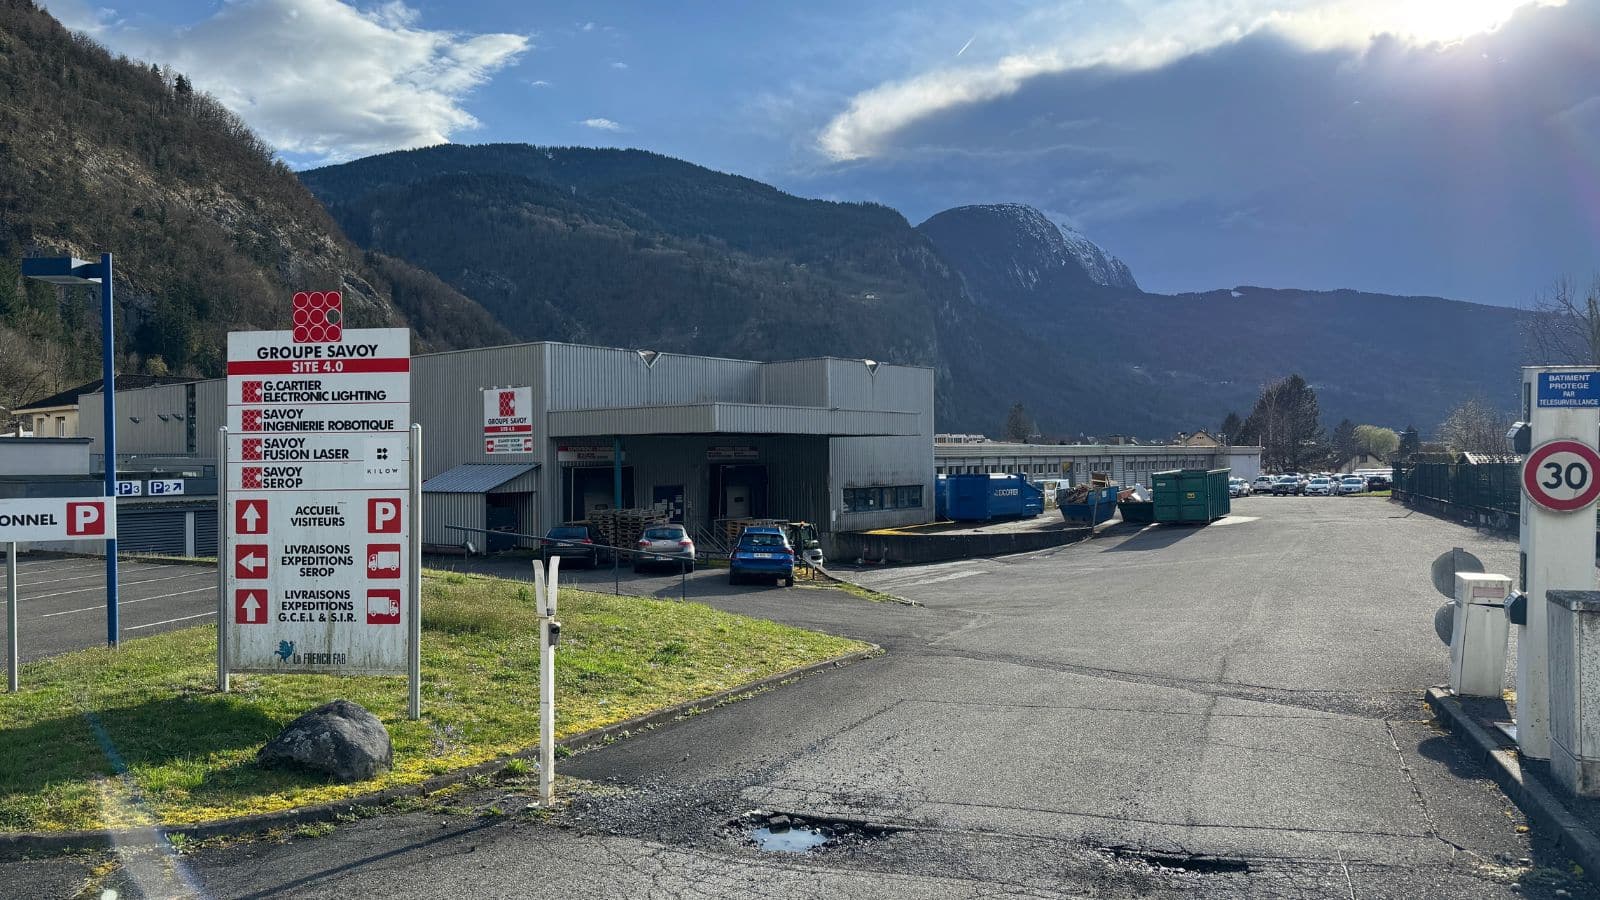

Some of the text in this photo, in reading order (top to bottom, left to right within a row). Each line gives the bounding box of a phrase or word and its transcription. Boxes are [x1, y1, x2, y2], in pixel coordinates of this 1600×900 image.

[257, 344, 378, 359] GROUPE SAVOY
[292, 361, 343, 372] SITE 4.0
[1549, 374, 1591, 382] BATIMENT
[264, 381, 321, 391] G.CARTIER
[1549, 382, 1590, 390] PROTEGE
[264, 391, 386, 402] ELECTRONIC LIGHTING
[1562, 390, 1576, 398] PAR
[1540, 398, 1599, 406] TELESURVEILLANCE
[263, 409, 304, 420] SAVOY
[264, 420, 394, 432] INGENIERIE ROBOTIQUE
[264, 438, 306, 449] SAVOY
[264, 449, 349, 460] FUSION LASER
[263, 467, 303, 477] SAVOY
[1542, 462, 1588, 490] 30
[263, 478, 303, 489] SEROP
[295, 506, 340, 515] ACCUEIL
[75, 505, 99, 532] P
[376, 502, 396, 530] P
[291, 517, 345, 527] VISITEURS
[285, 545, 350, 554] LIVRAISONS
[281, 556, 354, 566] EXPEDITIONS
[299, 568, 335, 576] SEROP
[285, 590, 350, 599] LIVRAISONS
[281, 601, 354, 611] EXPEDITIONS
[278, 613, 357, 622] G.C.E.L & S.I.R.
[303, 653, 331, 664] FRENCH
[333, 653, 346, 664] FAB
